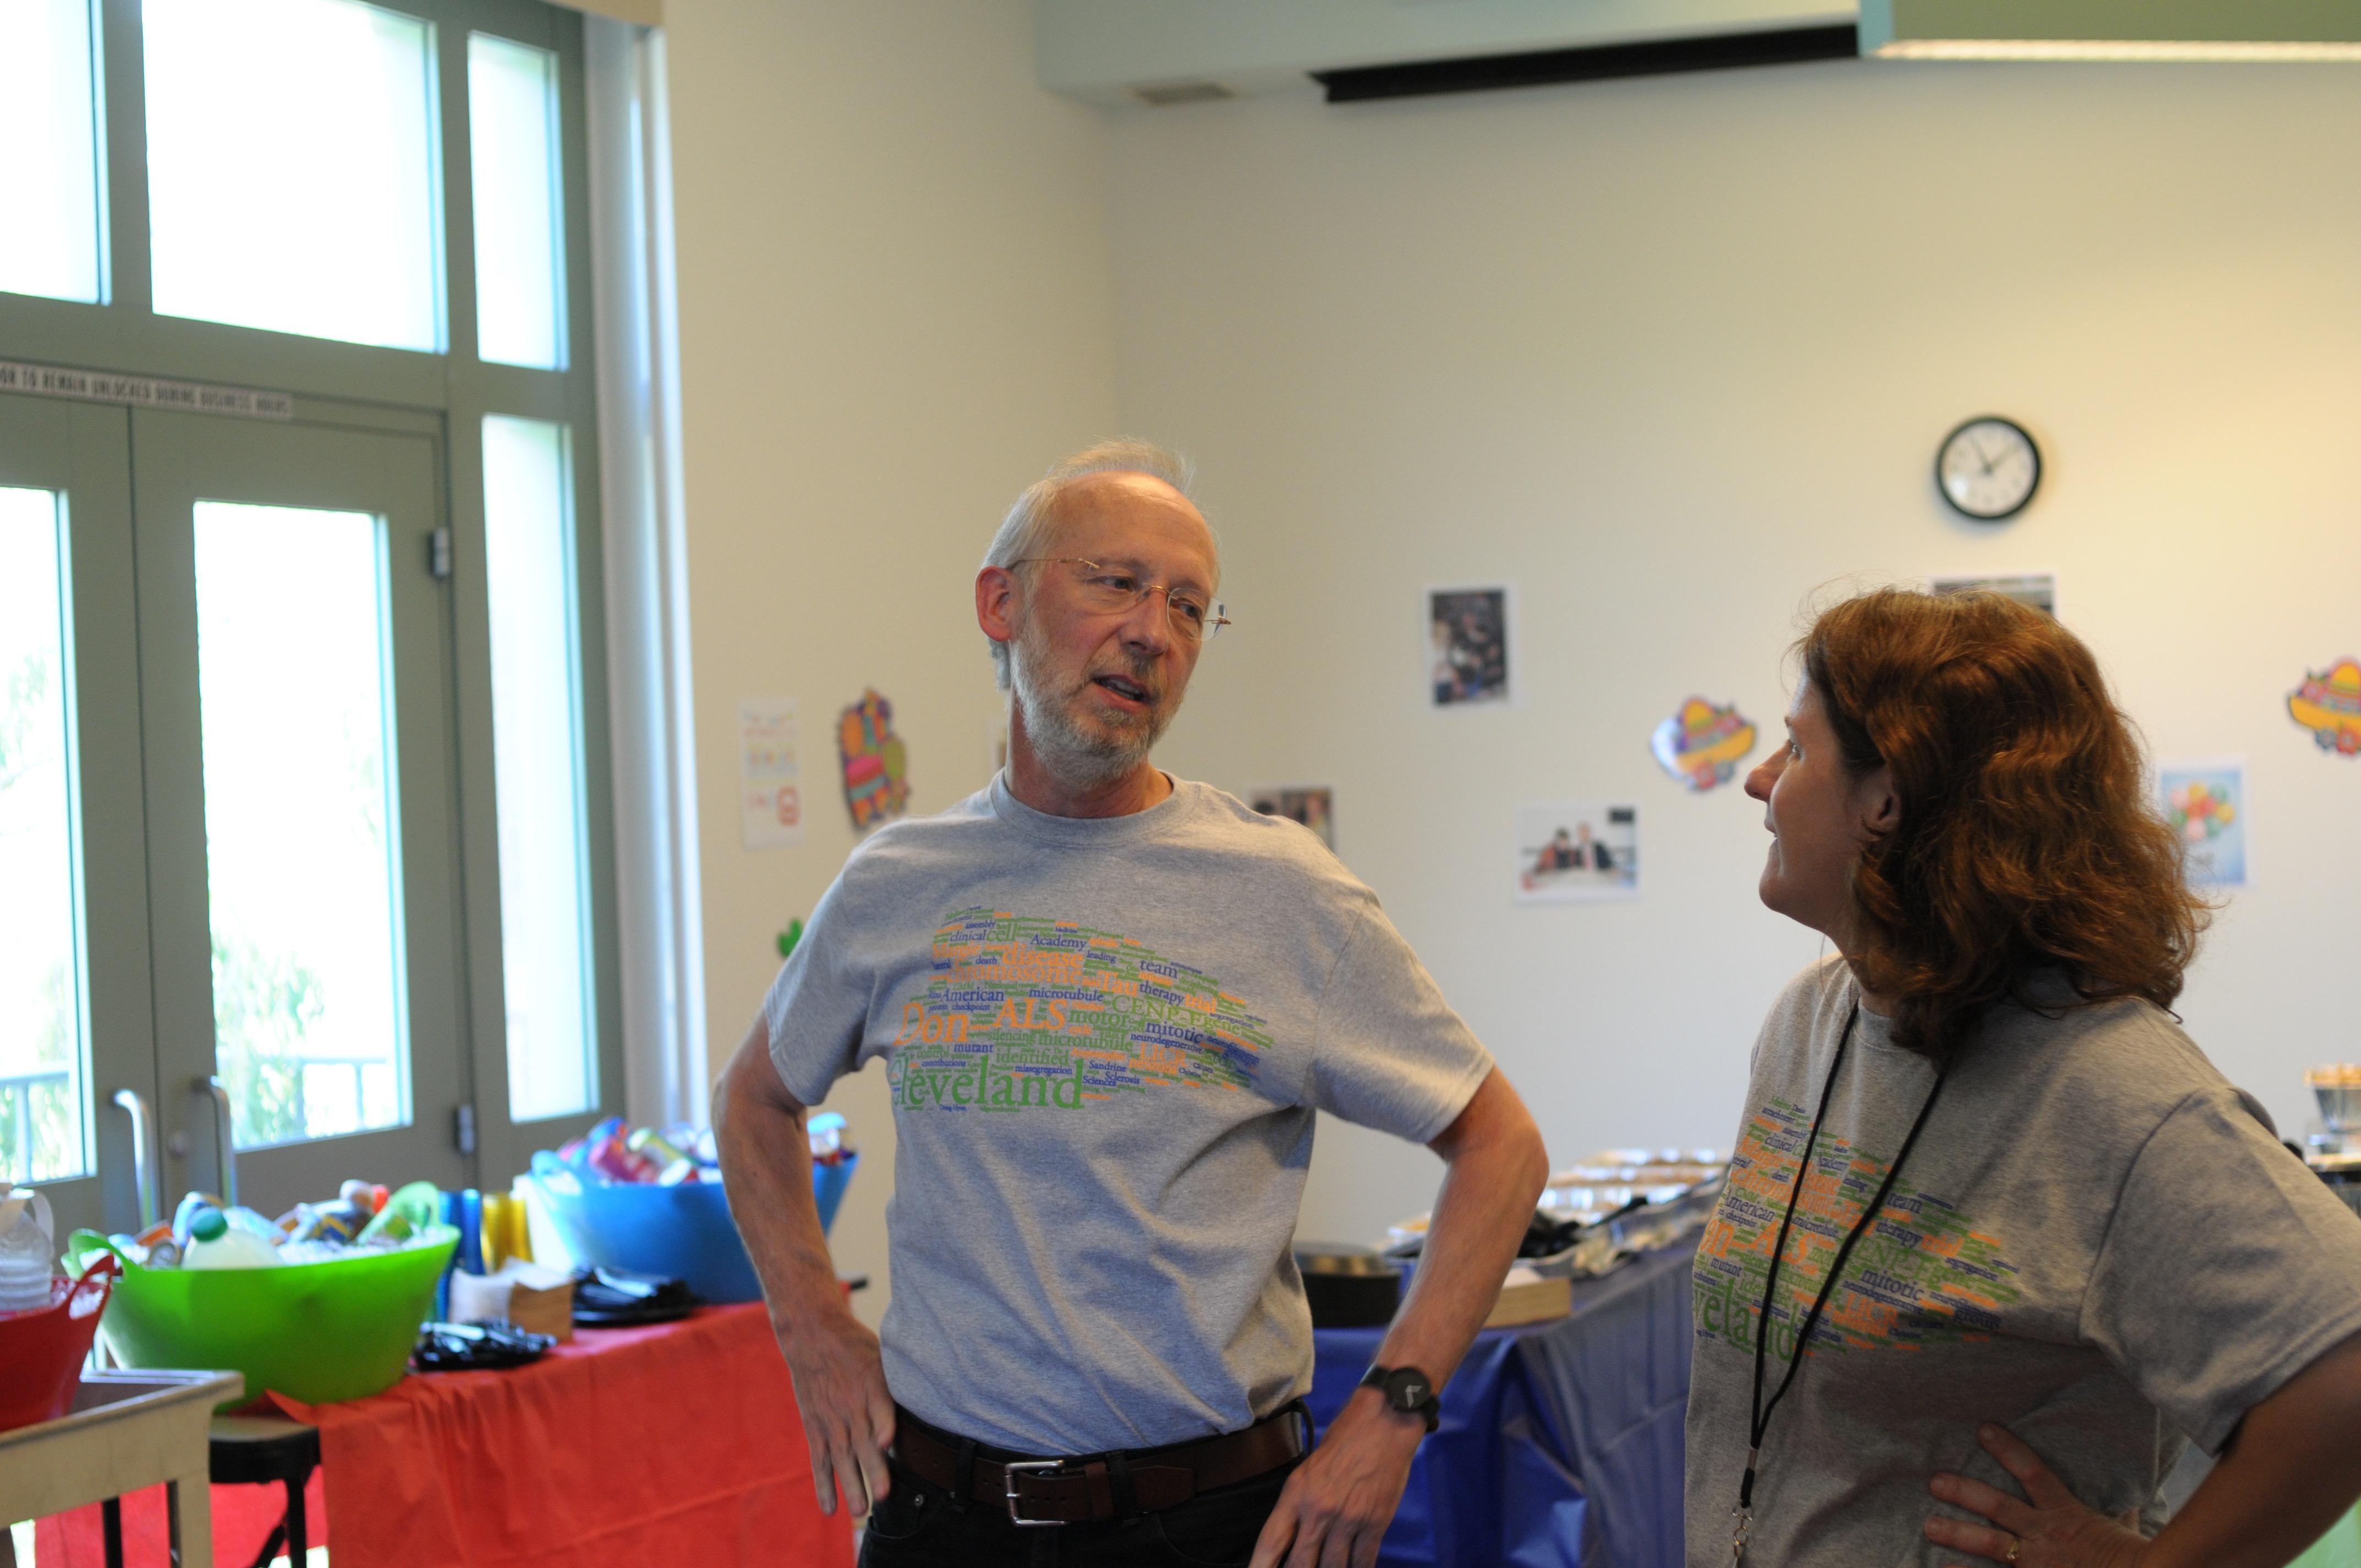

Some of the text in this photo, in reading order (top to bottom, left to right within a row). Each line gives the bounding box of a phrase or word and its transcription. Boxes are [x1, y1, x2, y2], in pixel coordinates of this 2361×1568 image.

[950, 929, 986, 942] clinical
[986, 922, 1016, 942] cell
[1031, 933, 1087, 951] Academy
[976, 956, 997, 965] death
[1002, 941, 1084, 969] disease
[1087, 950, 1116, 963] leading
[946, 958, 1083, 985] chromosome
[1140, 960, 1178, 979] team
[1097, 970, 1138, 997] Tau
[1139, 980, 1184, 1006] therapy
[940, 986, 1005, 1001] American
[1029, 987, 1105, 1001] microtubule
[952, 1001, 990, 1012] checkpoint
[1185, 993, 1216, 1014] trial
[1069, 1009, 1128, 1028] motor
[1210, 1012, 1255, 1030] segregation
[1039, 1031, 1134, 1053] microtubule
[1146, 1021, 1204, 1044] mitotic
[954, 1044, 994, 1053] mutant
[1130, 1033, 1203, 1054] neurodegenerative
[921, 1058, 967, 1067] contributions
[995, 1047, 1069, 1066] identified
[1089, 1060, 1127, 1072] Sandrine
[1105, 1071, 1140, 1085] Sclerosis
[1765, 1133, 1798, 1152] clinical
[1725, 1190, 1776, 1222] American
[1886, 1193, 1923, 1214] team
[1710, 1257, 1742, 1277] mutant
[1860, 1268, 1924, 1301] mitotic
